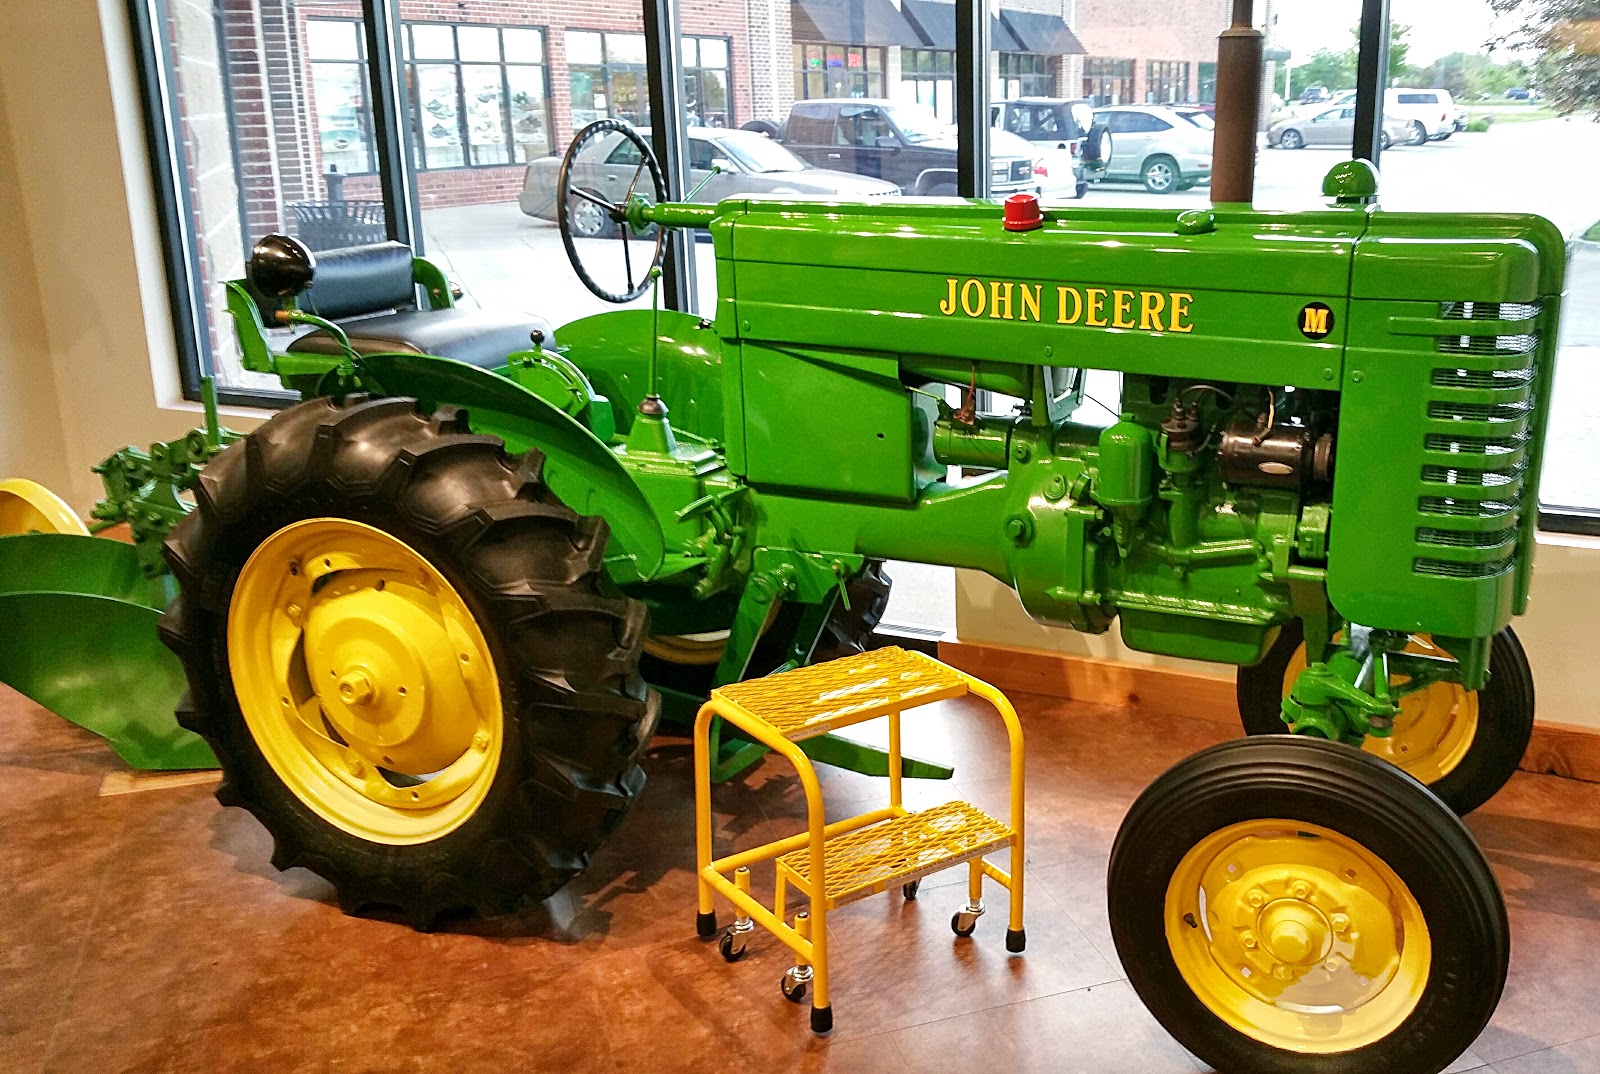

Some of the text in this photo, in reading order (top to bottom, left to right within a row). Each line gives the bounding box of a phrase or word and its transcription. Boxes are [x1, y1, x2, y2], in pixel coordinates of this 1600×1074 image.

[939, 278, 1194, 333] JOHN DEERE
[1302, 307, 1330, 334] M
